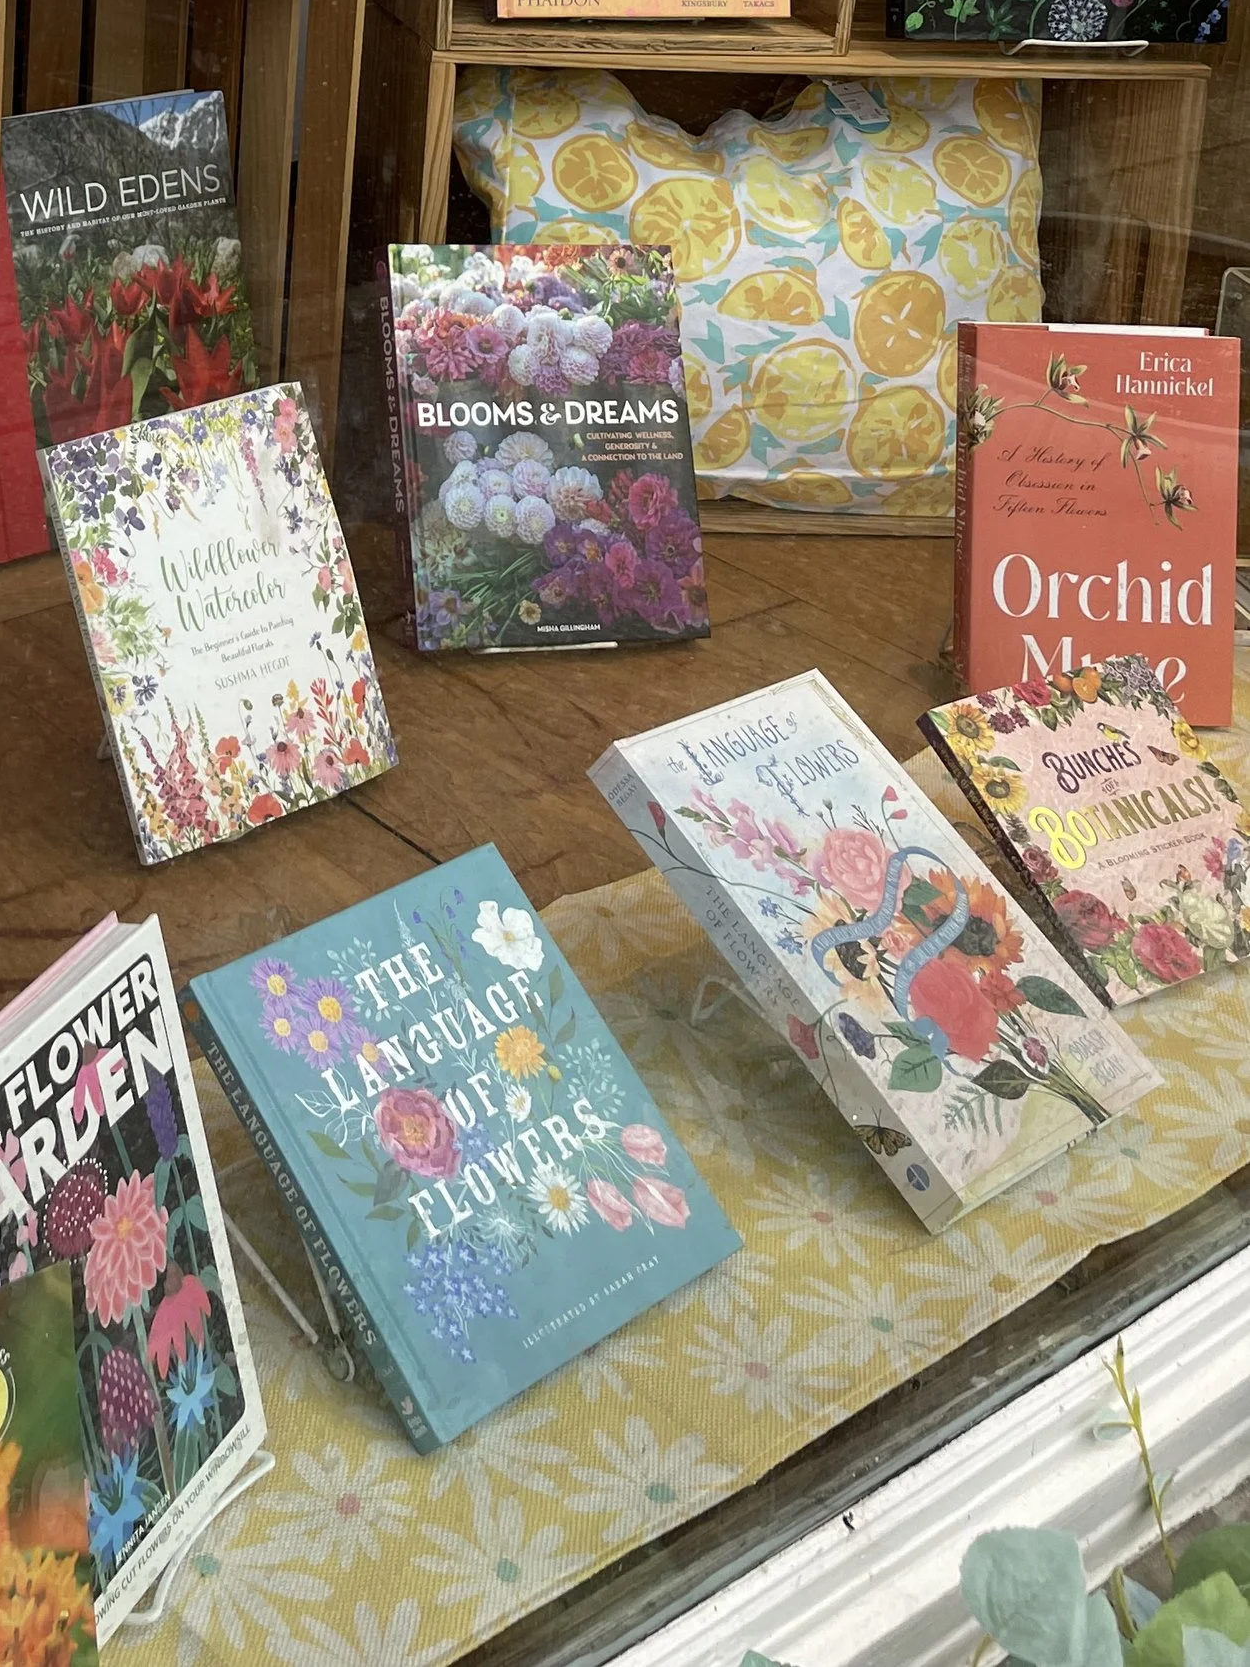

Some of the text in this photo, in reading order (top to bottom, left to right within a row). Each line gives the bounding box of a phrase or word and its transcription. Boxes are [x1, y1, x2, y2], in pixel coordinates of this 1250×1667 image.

[682, 0, 728, 8] KINGSBURY
[743, 0, 775, 8] TAKACS
[20, 163, 220, 222] WILD EDENS
[1115, 374, 1214, 397] Hannickel
[1139, 351, 1192, 374] Erica
[417, 399, 680, 427] BLOOMS & DREAMS
[160, 536, 280, 593] Wildflower
[992, 553, 1213, 626] Orchid
[176, 571, 286, 632] Watercolor
[537, 623, 601, 633] MISHA GILLINGHAM
[214, 655, 291, 691] SUSHMA HEGDE
[663, 711, 799, 786] the LANGUAGE of
[755, 738, 860, 797] FLOWERS
[1041, 739, 1142, 794] BUNCHES
[1028, 775, 1221, 870] BOTANICALS!
[1099, 833, 1208, 870] A BLOOMING STICKER BOOK
[355, 940, 447, 1013] THE
[4, 958, 161, 1130] FLOWER
[320, 968, 546, 1113] LANGUAGE
[444, 1069, 502, 1130] OF
[407, 1097, 612, 1240] FLOWERS
